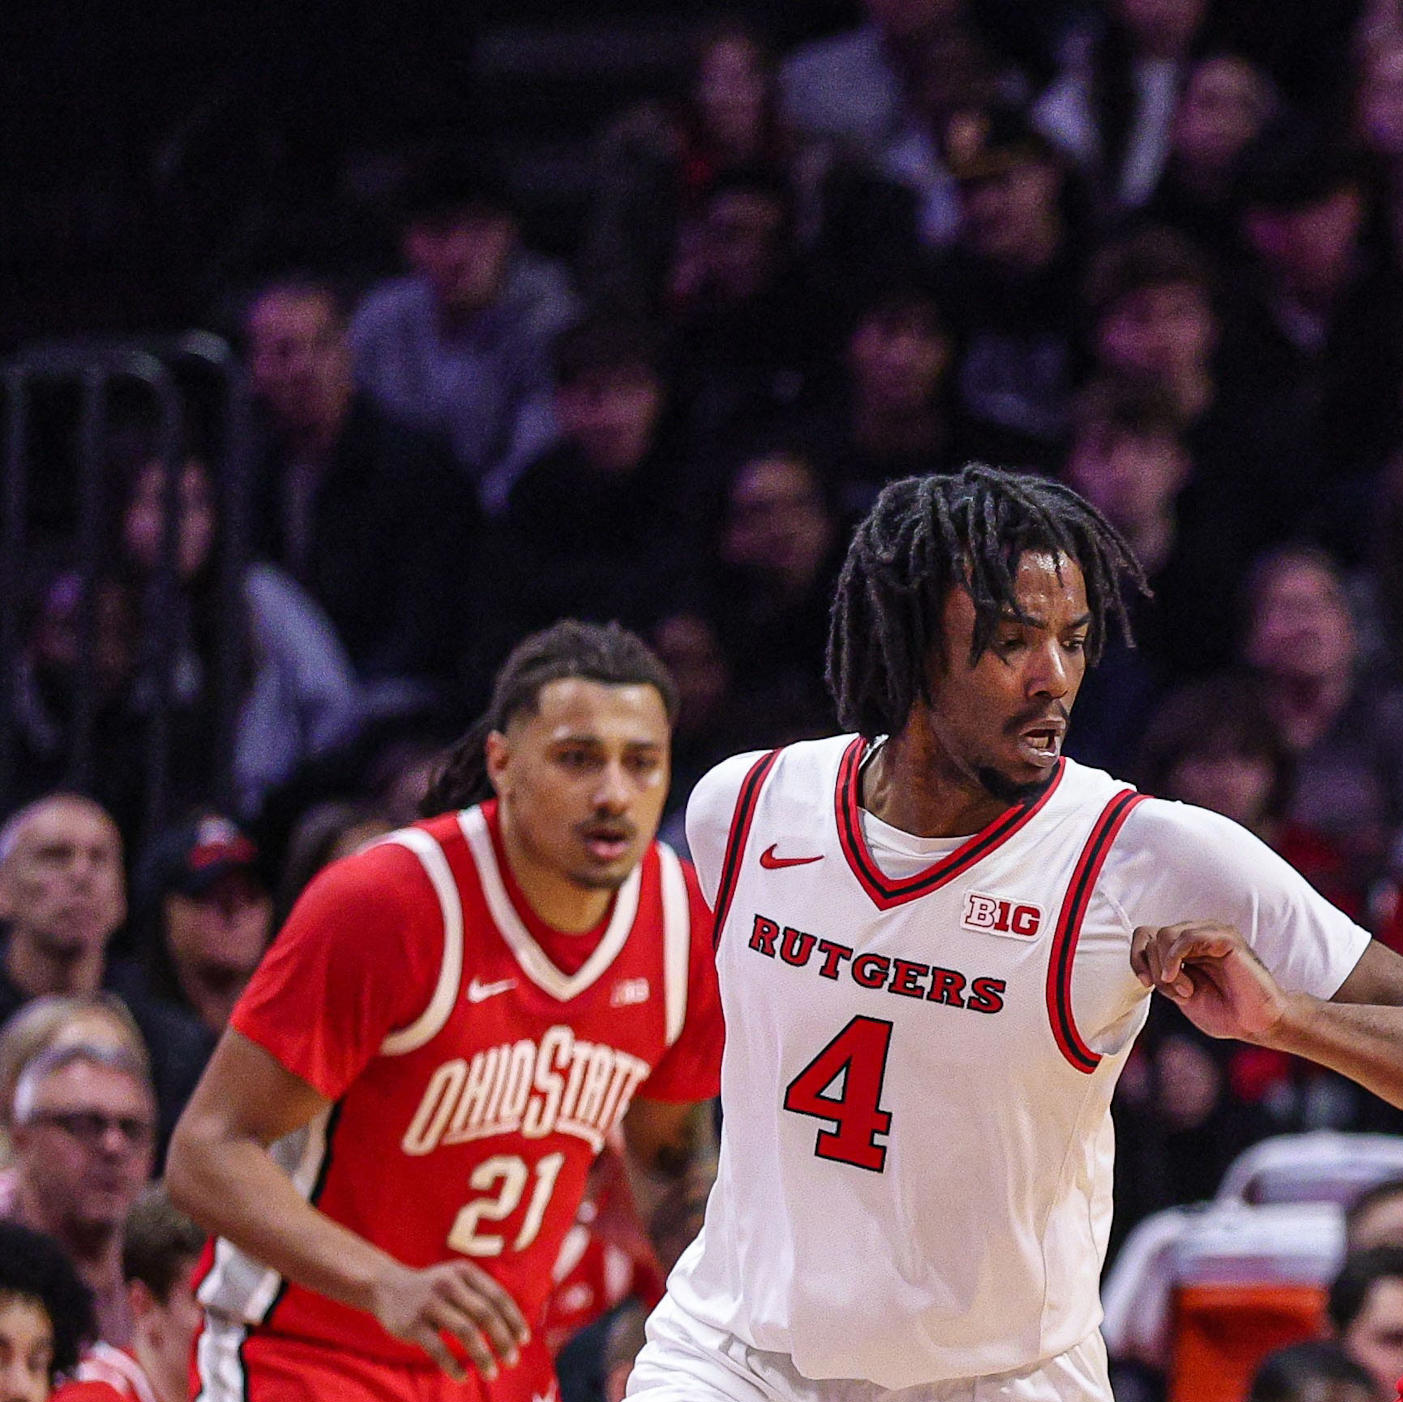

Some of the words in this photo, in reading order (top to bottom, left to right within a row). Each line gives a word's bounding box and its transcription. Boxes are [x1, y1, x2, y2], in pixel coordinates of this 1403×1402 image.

[749, 913, 1006, 1013] RUTGERS
[783, 1014, 893, 1173] 4
[446, 1152, 565, 1257] 21
